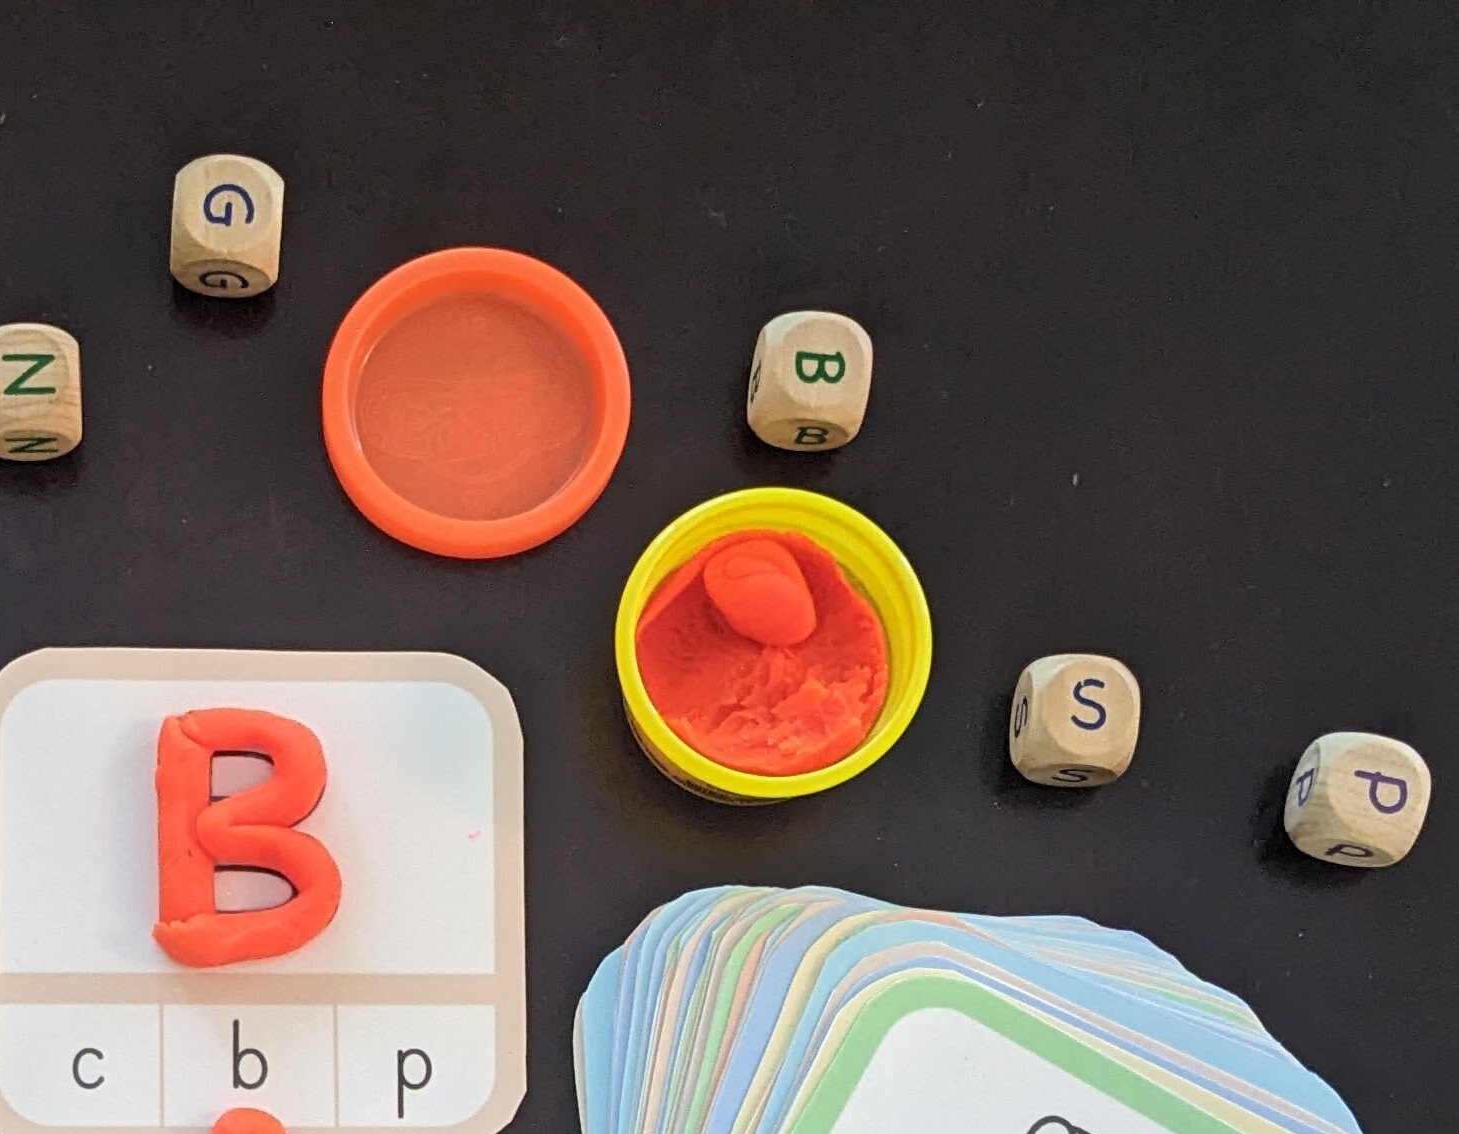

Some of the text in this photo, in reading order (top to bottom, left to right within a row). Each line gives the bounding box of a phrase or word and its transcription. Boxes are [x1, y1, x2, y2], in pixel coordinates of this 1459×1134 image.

[203, 183, 255, 227] G
[198, 270, 249, 288] G
[795, 349, 846, 386] B
[795, 426, 828, 445] B
[1071, 678, 1107, 730] S
[1051, 769, 1089, 784] S
[1297, 768, 1315, 807] P
[1354, 769, 1408, 815] P
[152, 707, 342, 968] B
[72, 1047, 105, 1089] c
[233, 1020, 268, 1089] b
[397, 1048, 433, 1118] p
